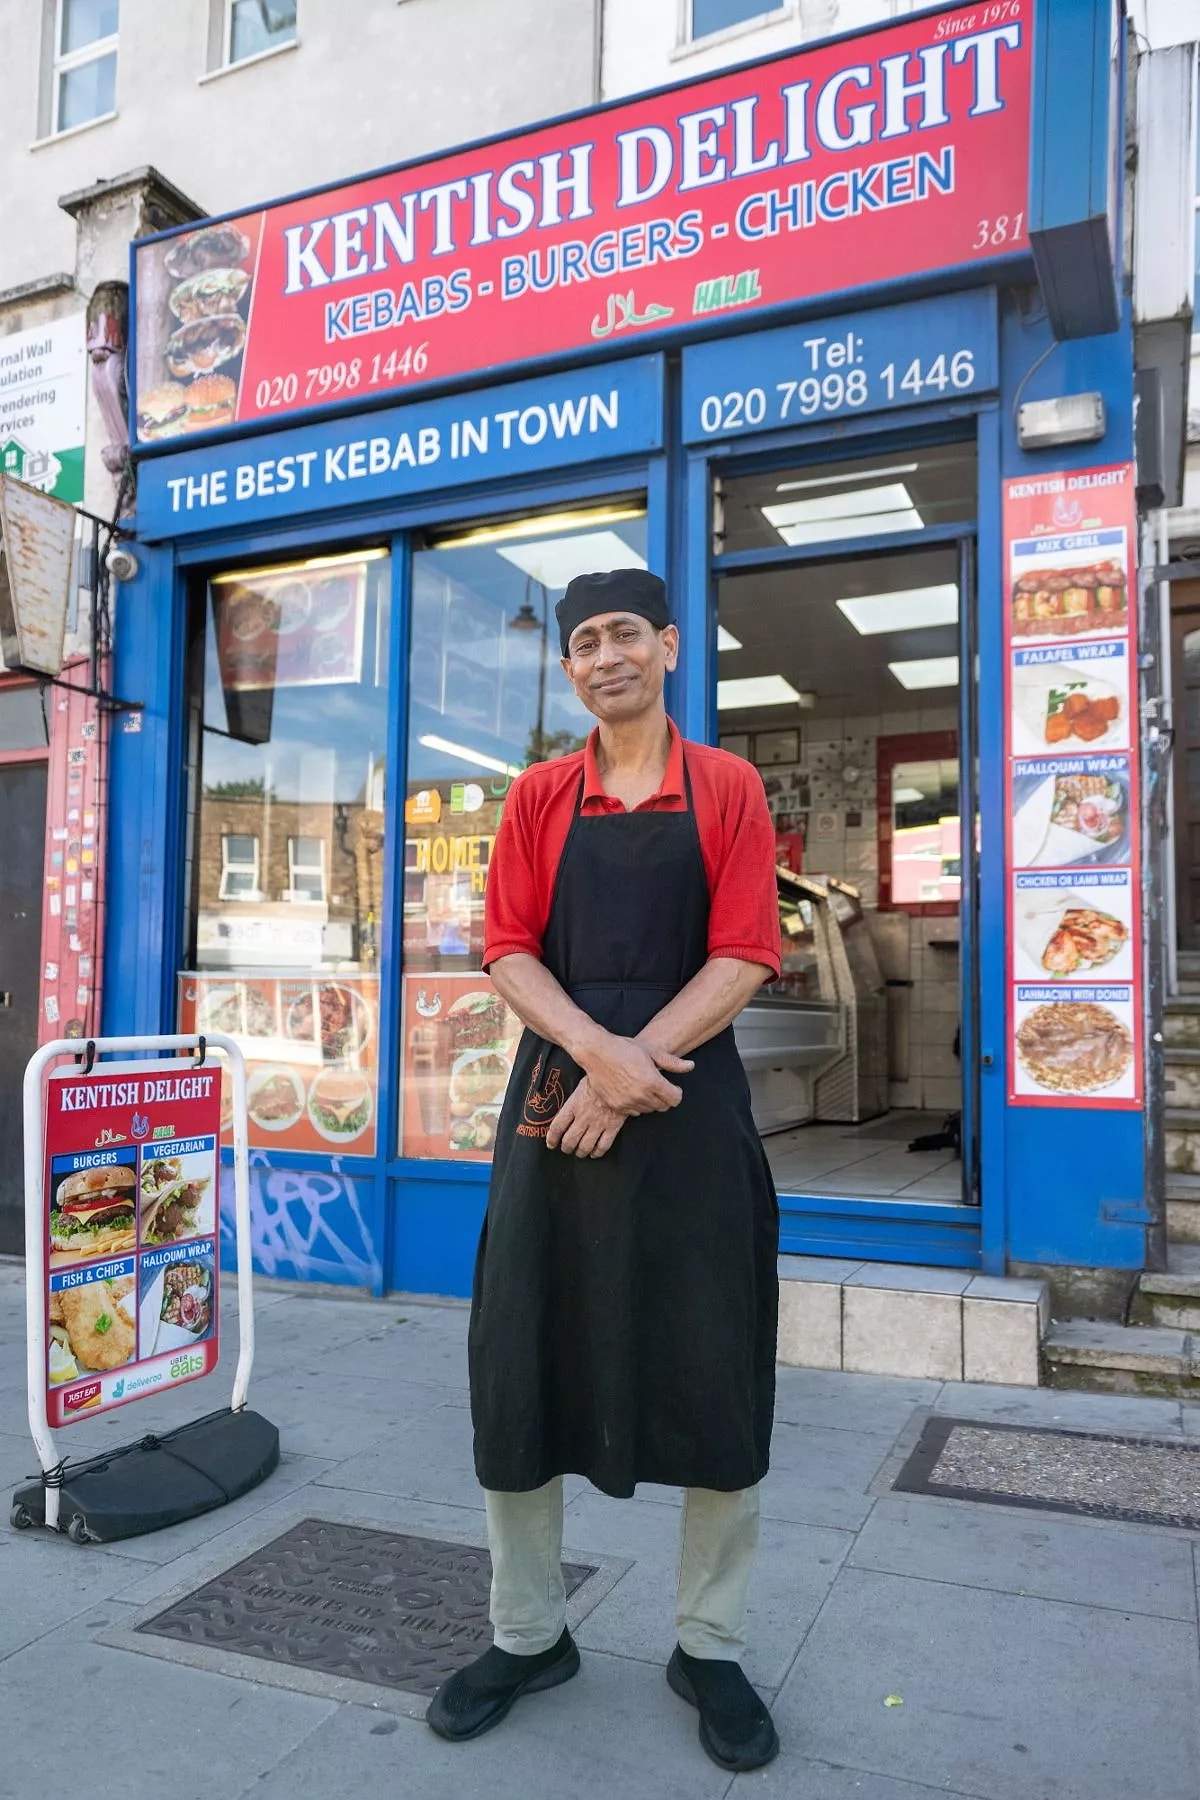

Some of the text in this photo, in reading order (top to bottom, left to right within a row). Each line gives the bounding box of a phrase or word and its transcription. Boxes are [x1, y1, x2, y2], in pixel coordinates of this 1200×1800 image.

[934, 0, 1020, 40] Since 1976
[283, 22, 1023, 297] KENTISH DELIGHT
[973, 212, 1025, 250] 381
[325, 270, 472, 344] KEBABS
[502, 210, 703, 299] BURGERS
[735, 145, 955, 243] CHICKEN
[692, 269, 761, 316] HALAL
[591, 289, 675, 339] حلال
[26, 338, 53, 360] Wall
[803, 332, 863, 371] Tel:
[0, 365, 42, 387] ulation
[256, 342, 430, 411] 020 7998 1446
[701, 349, 976, 432] 020 7998 1446
[168, 390, 620, 513] THE BEST KEBAB IN TOWN
[1009, 469, 1127, 499] KENTISH DELIGHT
[1035, 534, 1100, 553] MIX GRILL
[1022, 644, 1117, 664] FALAFEL WRAP
[1017, 757, 1127, 776] HALLOUMI WRAP
[416, 834, 481, 873] HOME
[1017, 876, 1058, 888] CHICKEN
[1058, 876, 1073, 886] OR
[60, 1077, 213, 1112] KENTISH DELIGHT
[73, 1152, 117, 1169] BURGERS
[153, 1140, 205, 1157] VEGETARIAN
[143, 1242, 212, 1268] HALLOUMI WRAP
[62, 1262, 125, 1288] FISH & CHIPS
[170, 1354, 187, 1365] UBER
[170, 1356, 203, 1378] eats
[68, 1386, 97, 1404] JUST EAT
[126, 1373, 162, 1391] deliveroo
